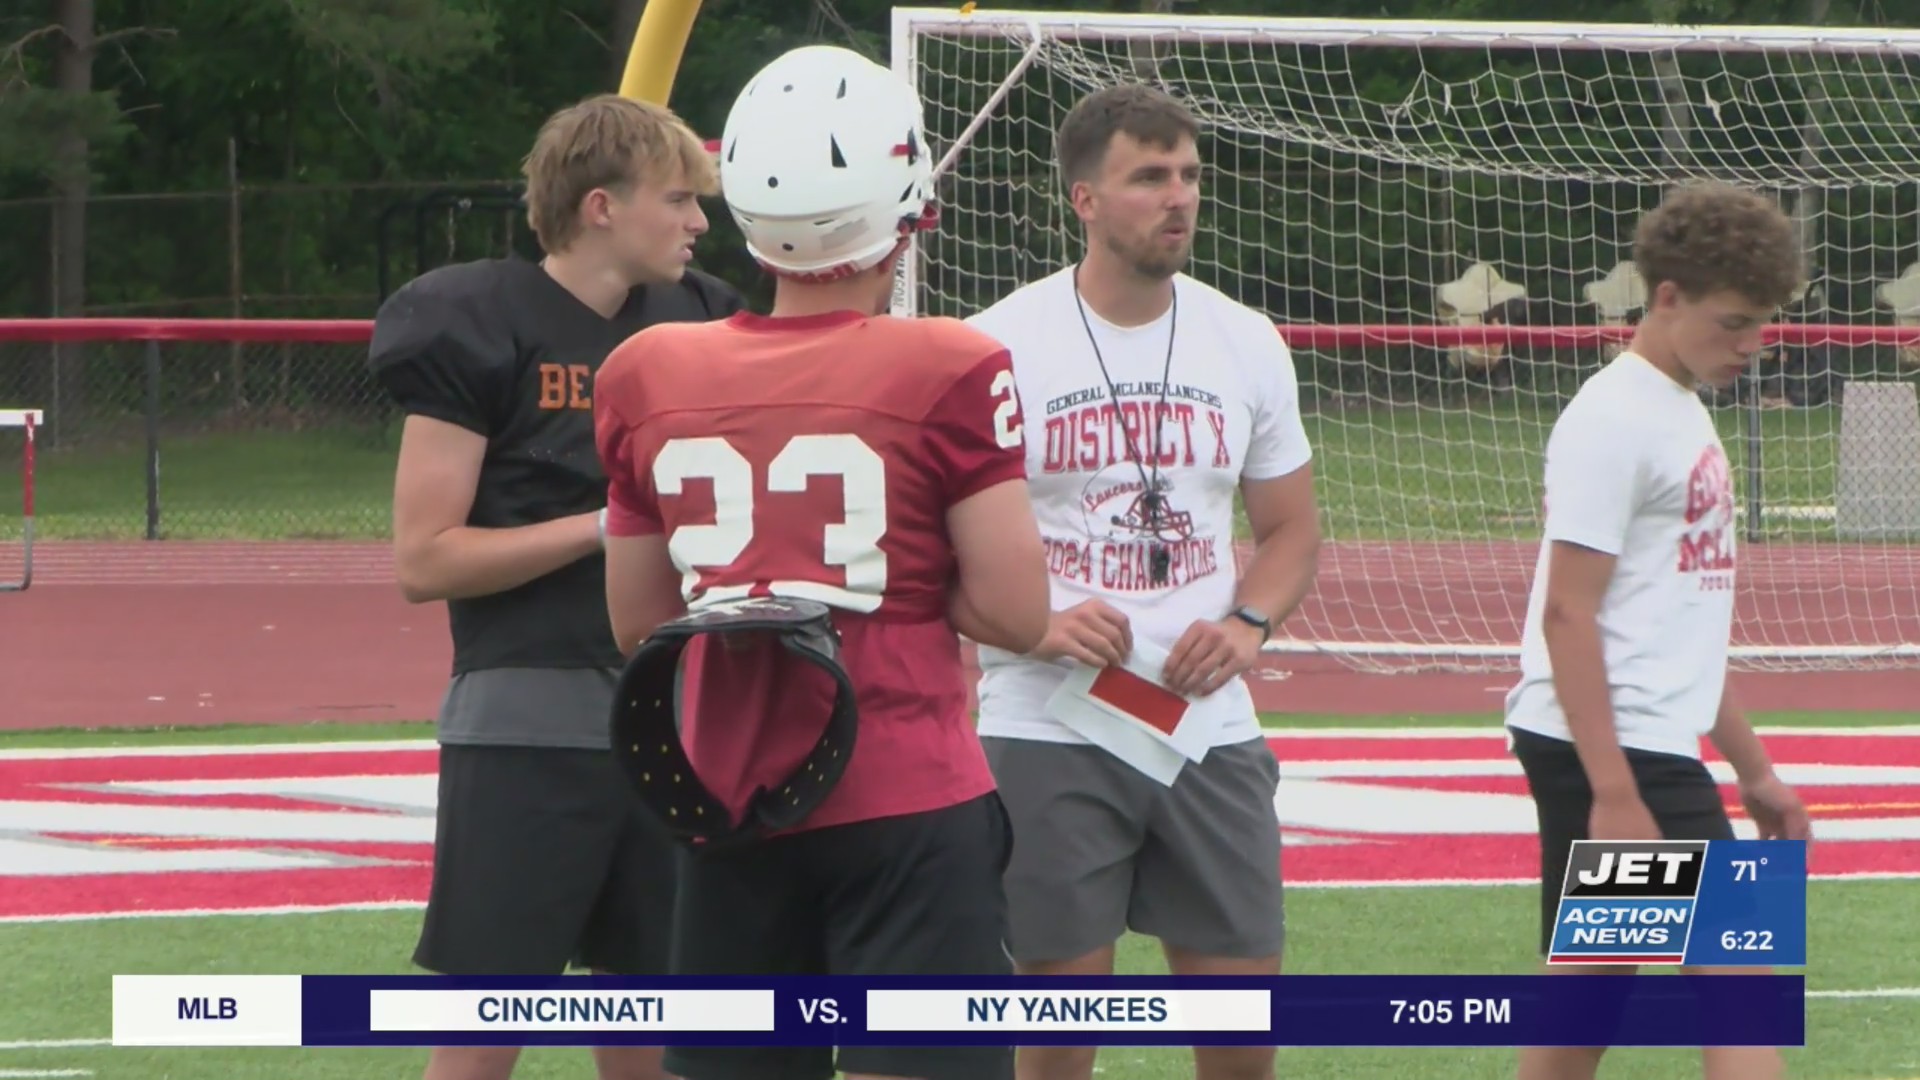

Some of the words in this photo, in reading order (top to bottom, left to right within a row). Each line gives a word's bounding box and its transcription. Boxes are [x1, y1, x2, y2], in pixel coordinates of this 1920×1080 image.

[989, 368, 1022, 448] 2
[1046, 386, 1106, 415] GENERAL
[1108, 381, 1162, 398] MCLANE
[1164, 383, 1223, 409] LANCERS
[1042, 400, 1196, 474] DISTRICT
[1206, 410, 1231, 468] X
[652, 433, 887, 613] 23
[1084, 480, 1144, 513] Lancers
